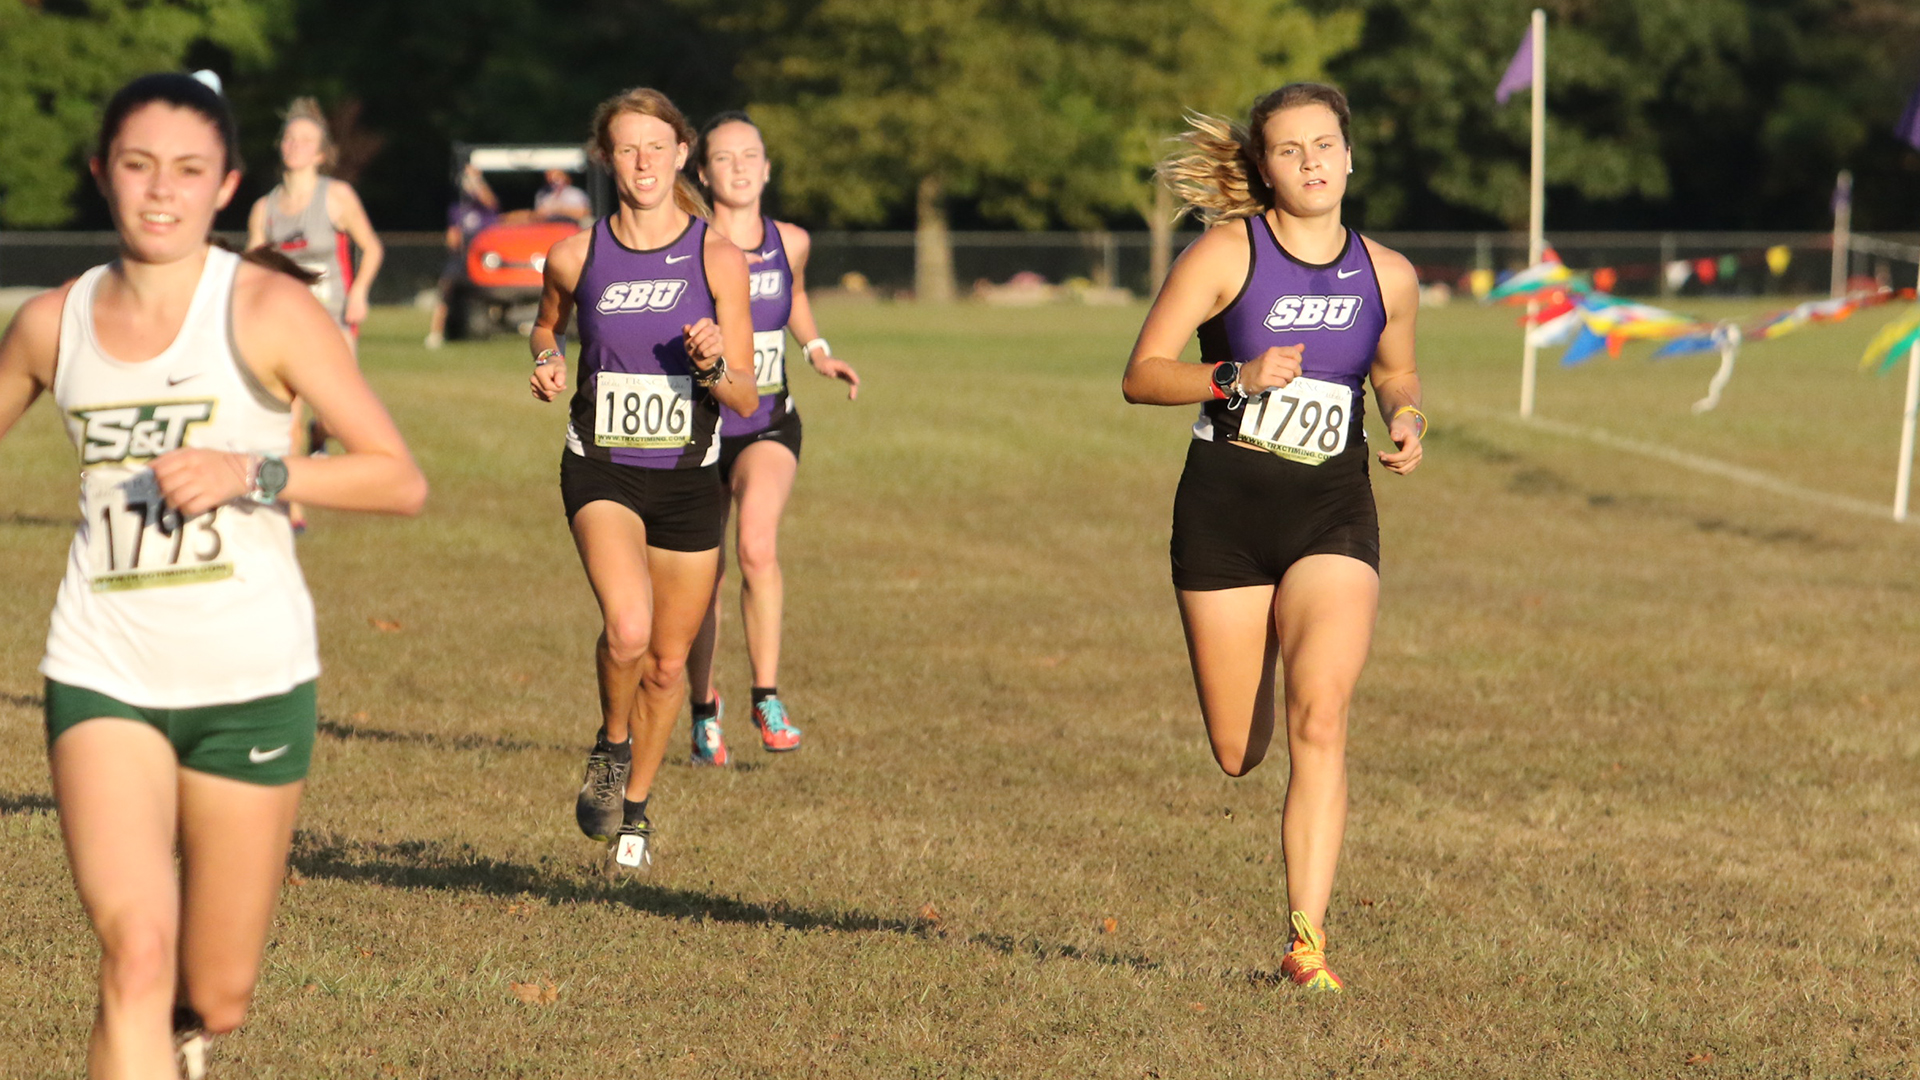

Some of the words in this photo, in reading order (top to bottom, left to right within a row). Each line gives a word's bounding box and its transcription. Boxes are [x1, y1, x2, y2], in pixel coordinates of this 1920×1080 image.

[598, 280, 685, 313] SBU
[1264, 296, 1361, 330] SBU
[78, 402, 210, 462] S&T
[606, 391, 685, 435] 1806
[1253, 391, 1343, 452] 1798
[104, 498, 221, 570] 1793
